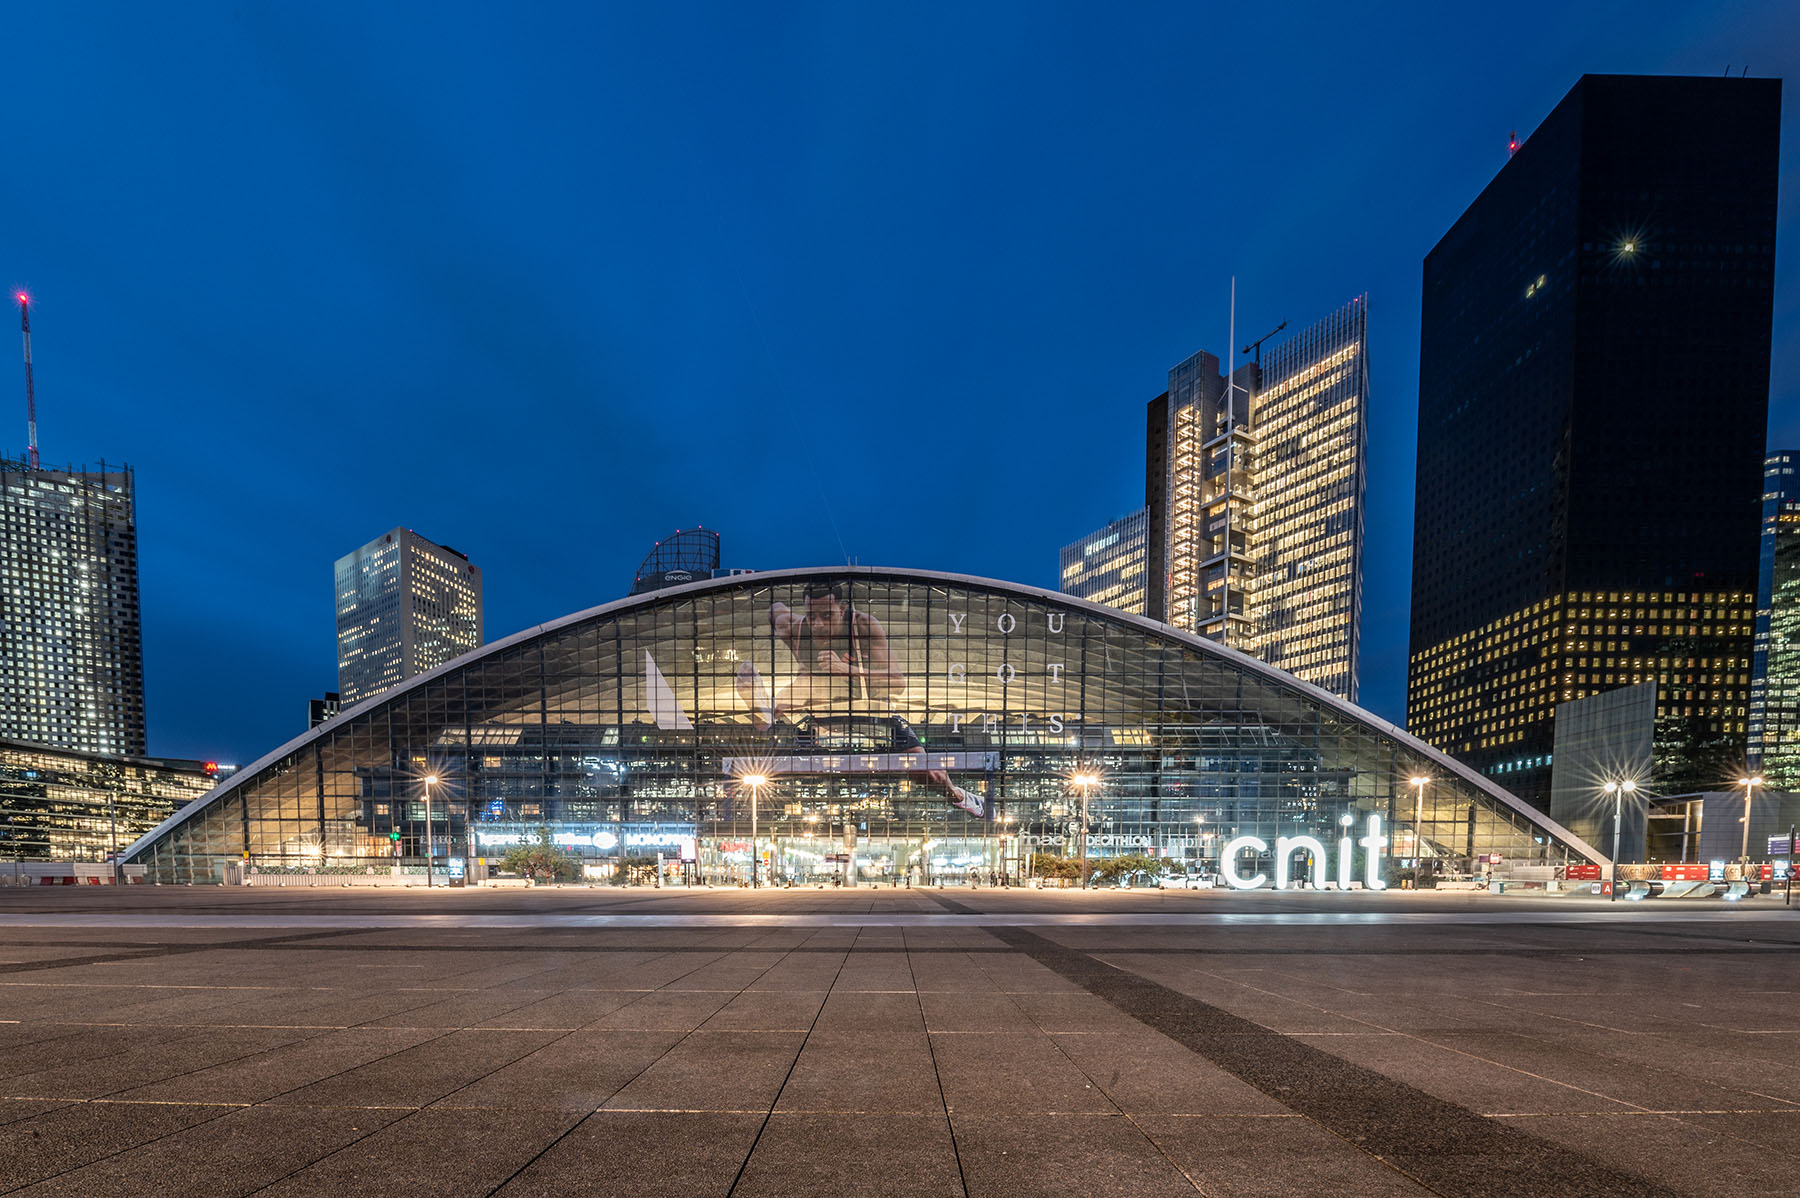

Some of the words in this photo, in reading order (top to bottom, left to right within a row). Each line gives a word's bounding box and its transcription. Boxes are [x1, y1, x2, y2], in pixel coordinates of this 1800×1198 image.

[949, 613, 1065, 634] YOU
[949, 663, 1064, 684] GOT
[948, 713, 1064, 734] THIS
[1221, 814, 1388, 890] cnit
